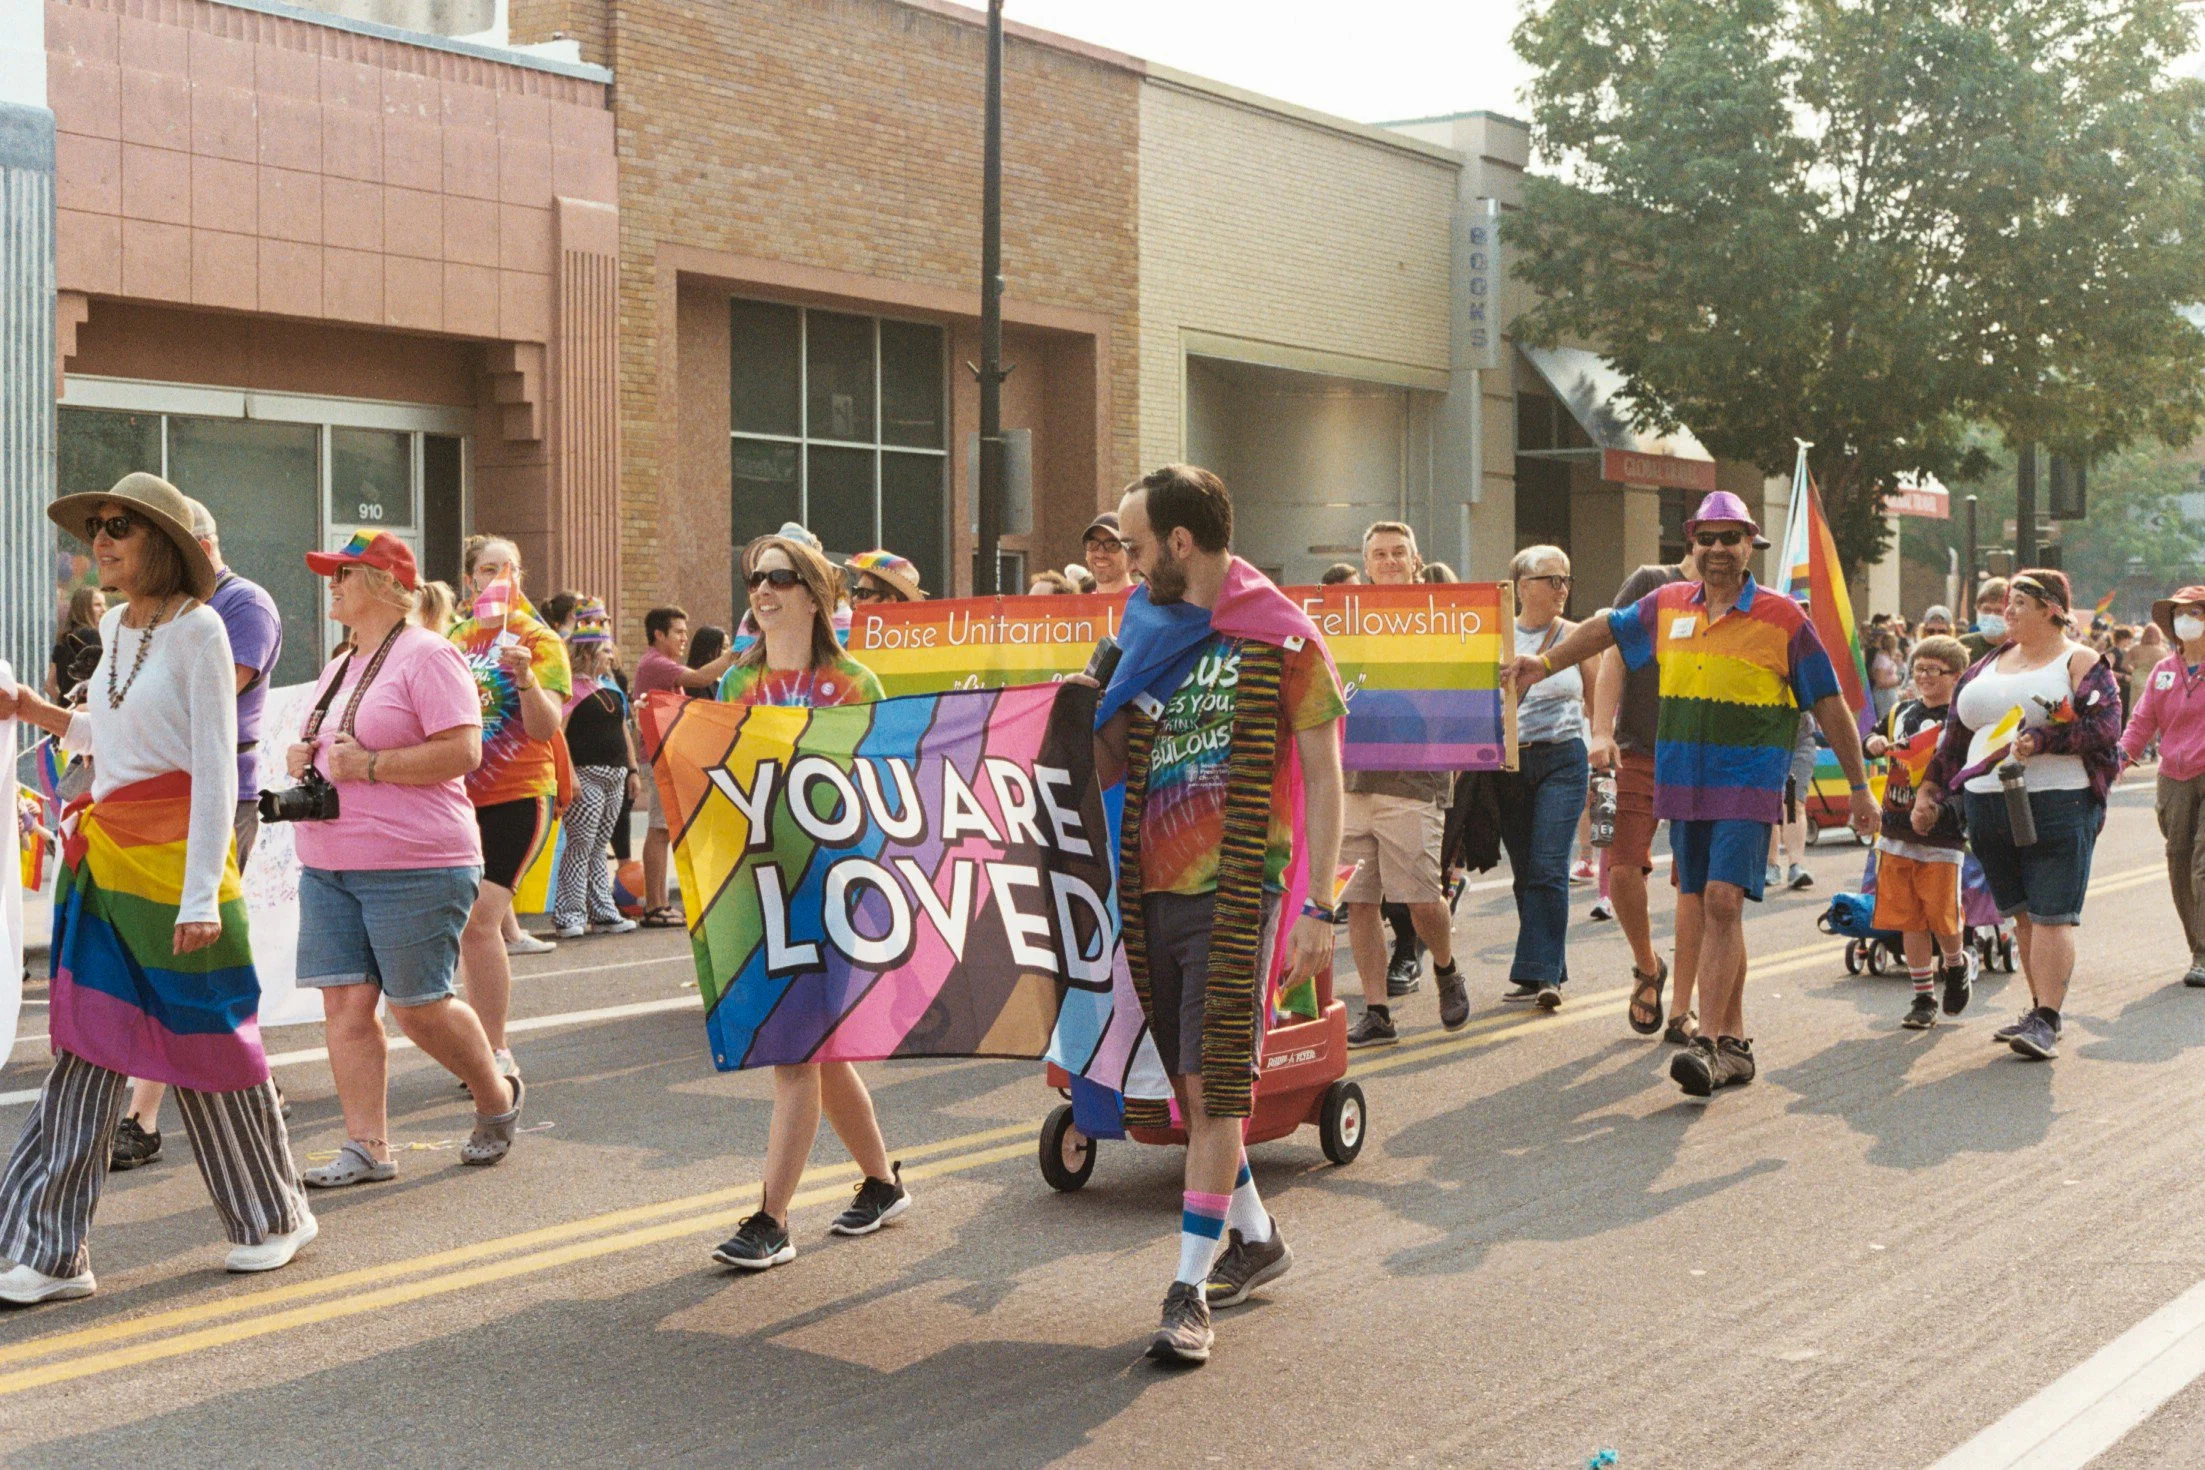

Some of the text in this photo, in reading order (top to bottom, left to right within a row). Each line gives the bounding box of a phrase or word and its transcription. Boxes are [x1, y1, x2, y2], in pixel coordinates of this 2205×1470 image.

[1470, 227, 1487, 346] BOOKS
[359, 503, 383, 519] 910
[865, 614, 937, 650] Boise
[948, 610, 1093, 646] Unitarian
[1190, 694, 1235, 713] YOU.
[709, 757, 1093, 857] YOU ARE
[756, 859, 1112, 982] LOVED
